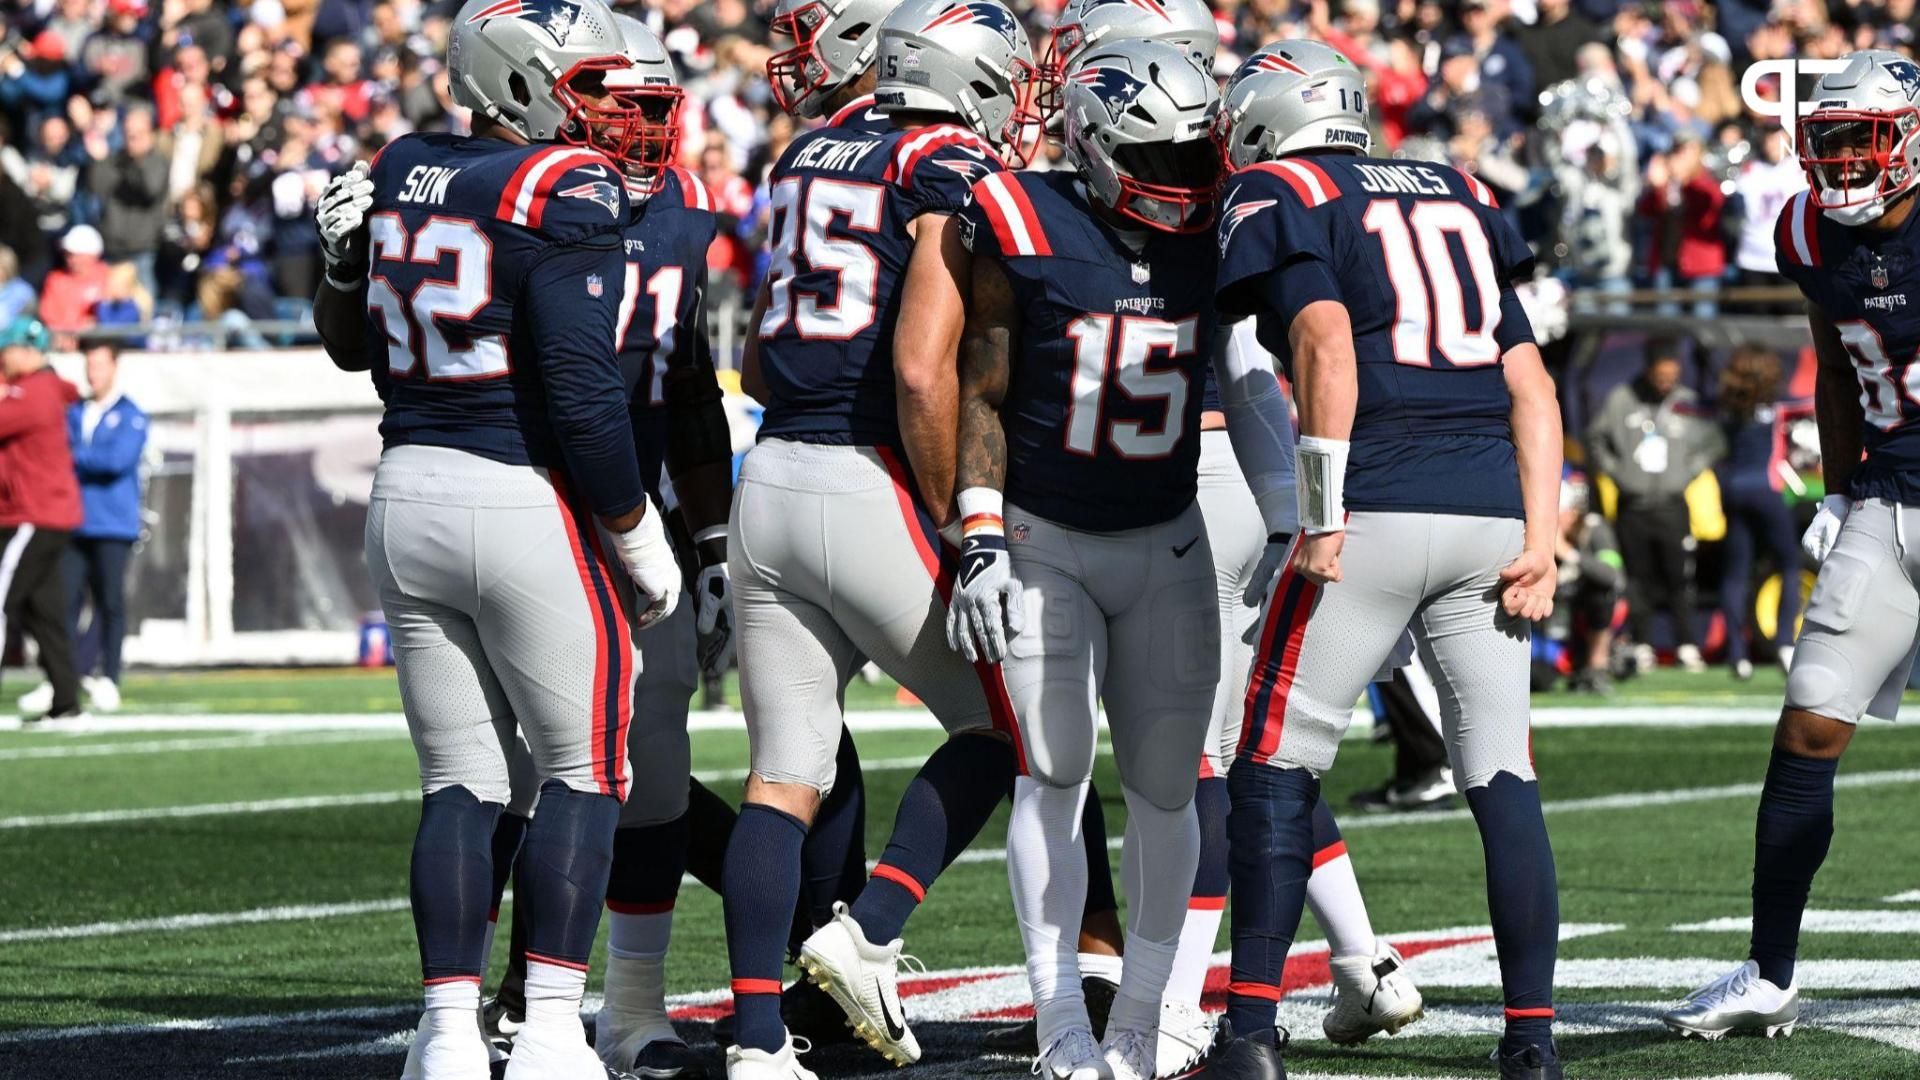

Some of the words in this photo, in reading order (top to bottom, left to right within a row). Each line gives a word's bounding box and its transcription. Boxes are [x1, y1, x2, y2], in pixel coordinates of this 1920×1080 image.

[1339, 88, 1363, 113] 10
[791, 137, 882, 171] HENRY
[1325, 128, 1368, 149] PATRIOTS
[396, 165, 461, 205] SOW
[1353, 164, 1451, 195] JONES
[758, 176, 886, 340] 85
[368, 211, 514, 383] 62
[1362, 199, 1502, 367] 10
[1115, 297, 1165, 313] PATRIOTS
[1864, 294, 1907, 311] PATRIOTS
[1063, 312, 1199, 460] 15
[1834, 319, 1920, 432] 8
